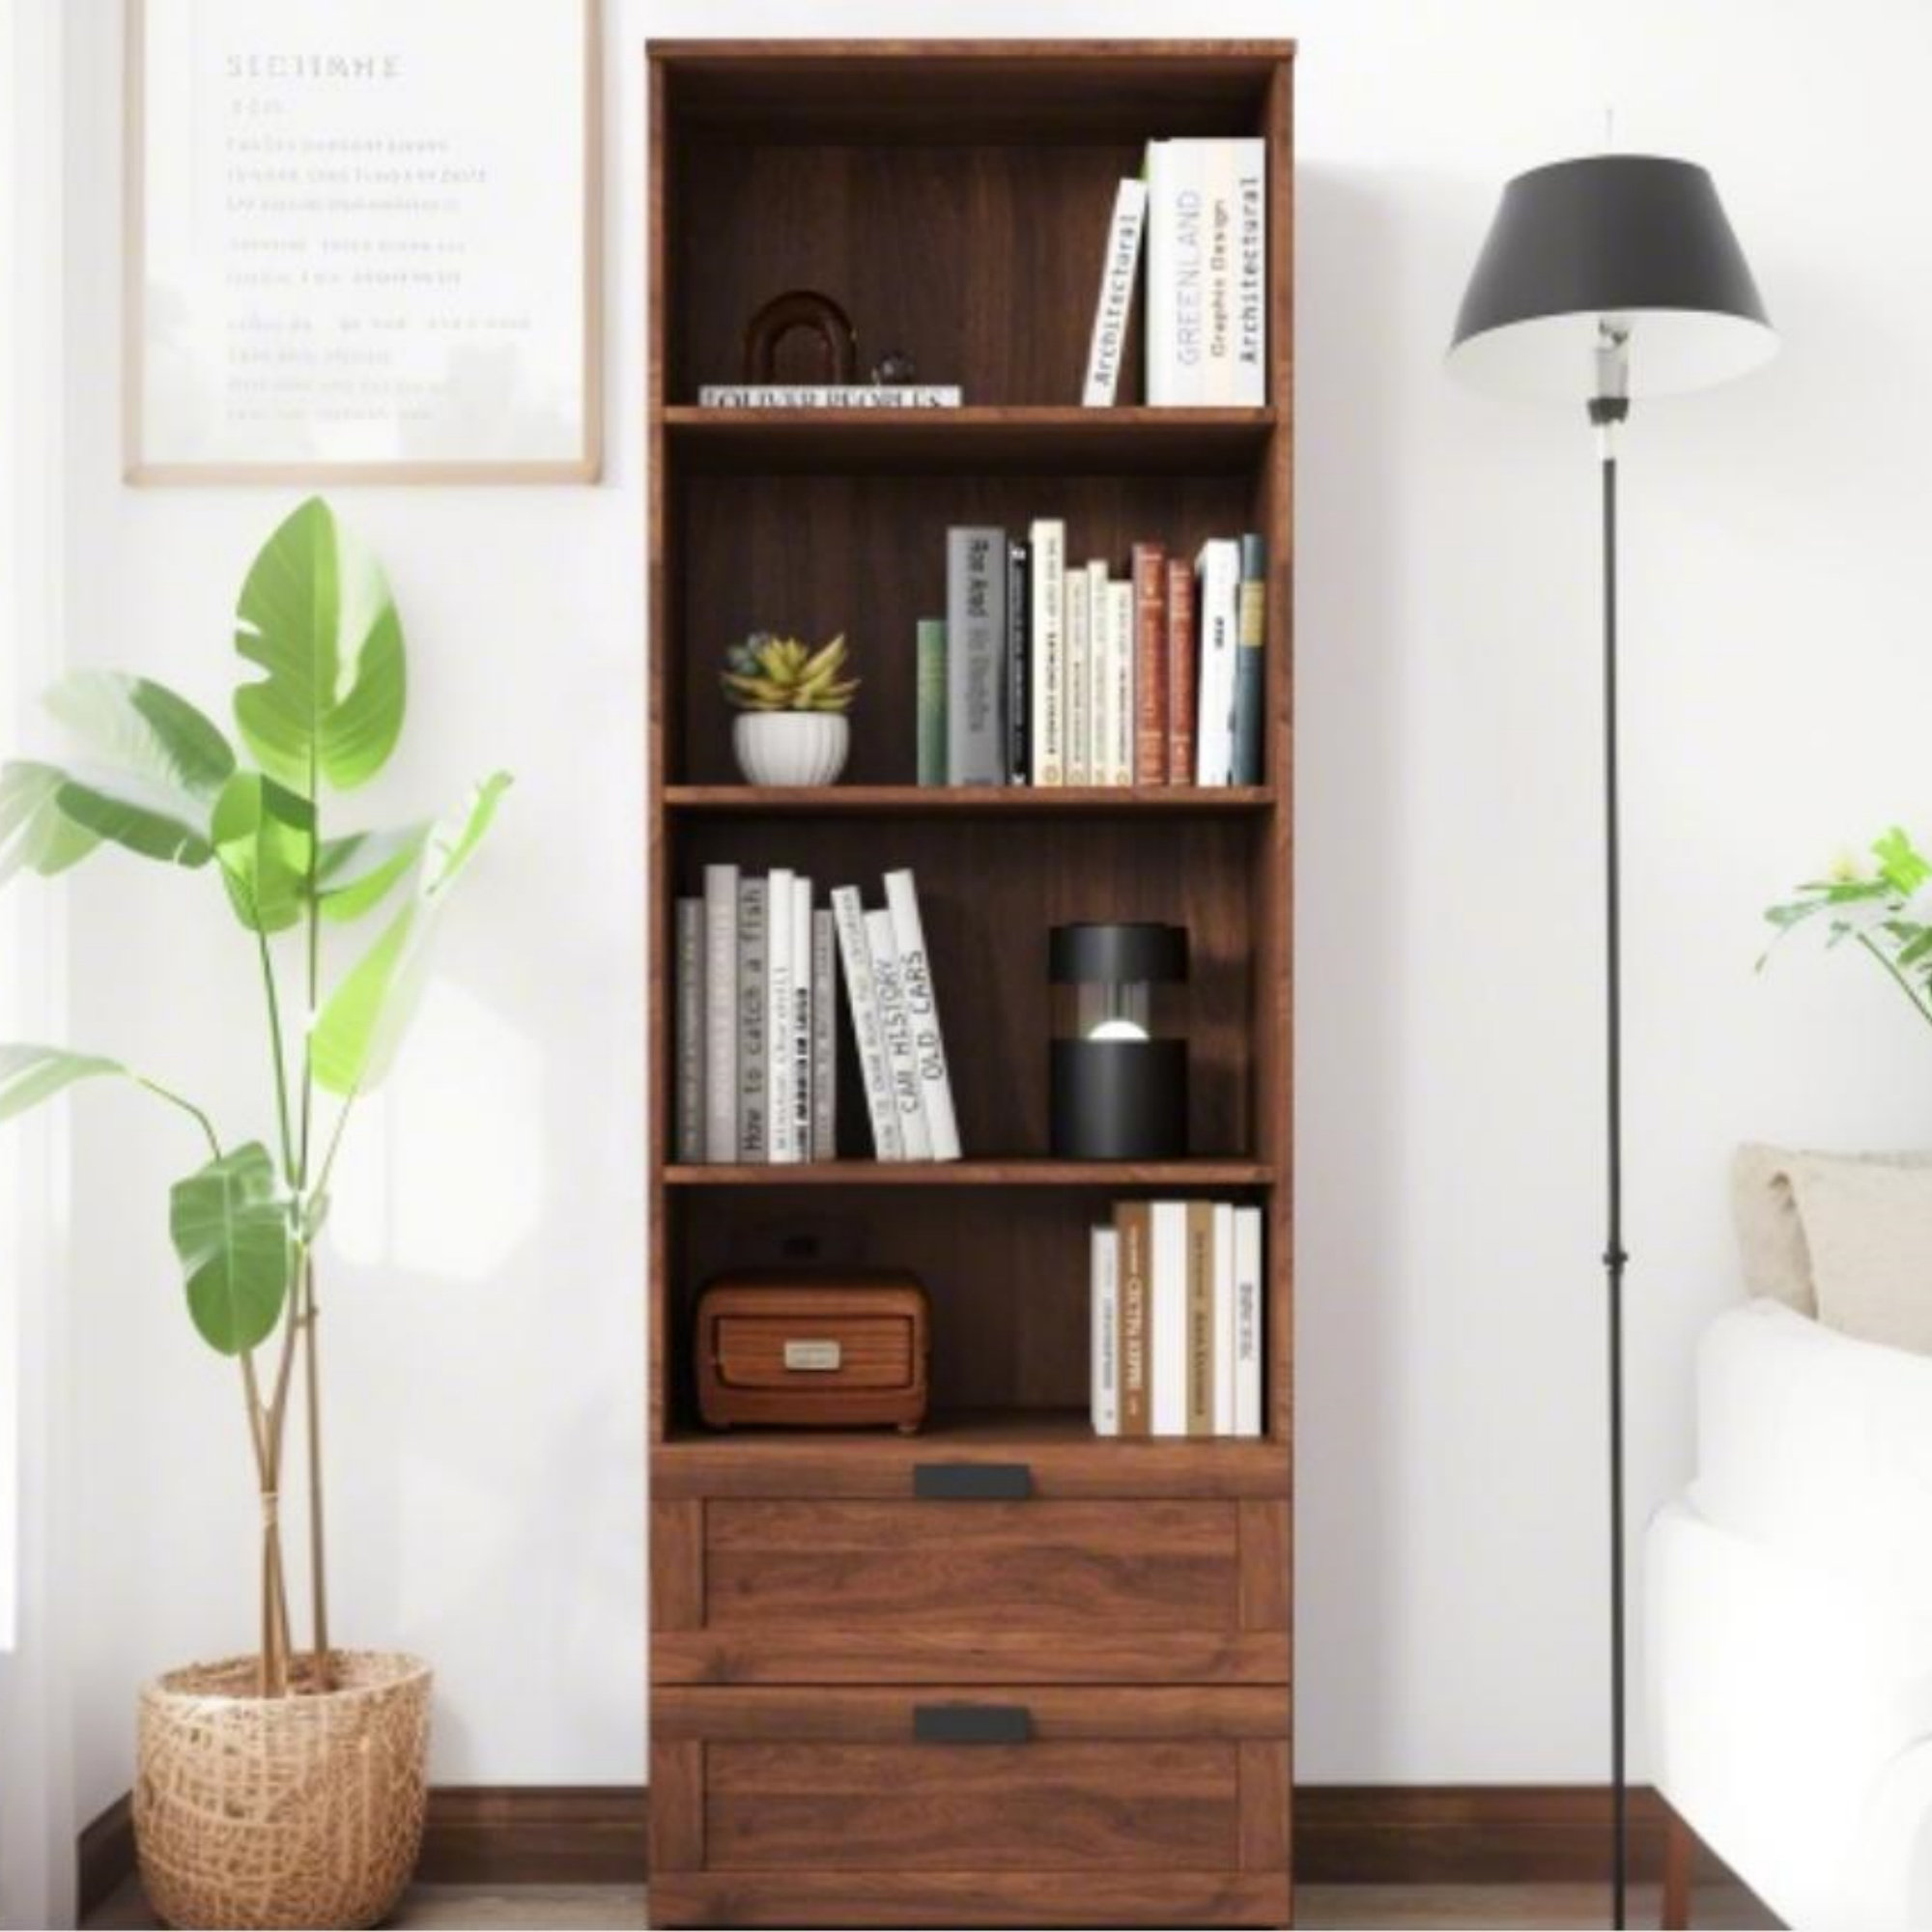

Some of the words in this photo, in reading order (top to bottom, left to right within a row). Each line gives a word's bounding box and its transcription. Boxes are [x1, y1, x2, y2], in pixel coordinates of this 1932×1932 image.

[1210, 198, 1229, 270] Design
[1094, 215, 1137, 385] Architectural
[1177, 190, 1201, 365] GREENLAND
[1239, 177, 1260, 364] Architectural
[1210, 278, 1229, 357] Graphic
[739, 889, 761, 941] fish
[747, 957, 761, 972] a
[901, 950, 931, 1015] CARS
[743, 984, 762, 1055] catch
[743, 1067, 762, 1094] to
[918, 1031, 943, 1081] OLD
[743, 1109, 762, 1151] How
